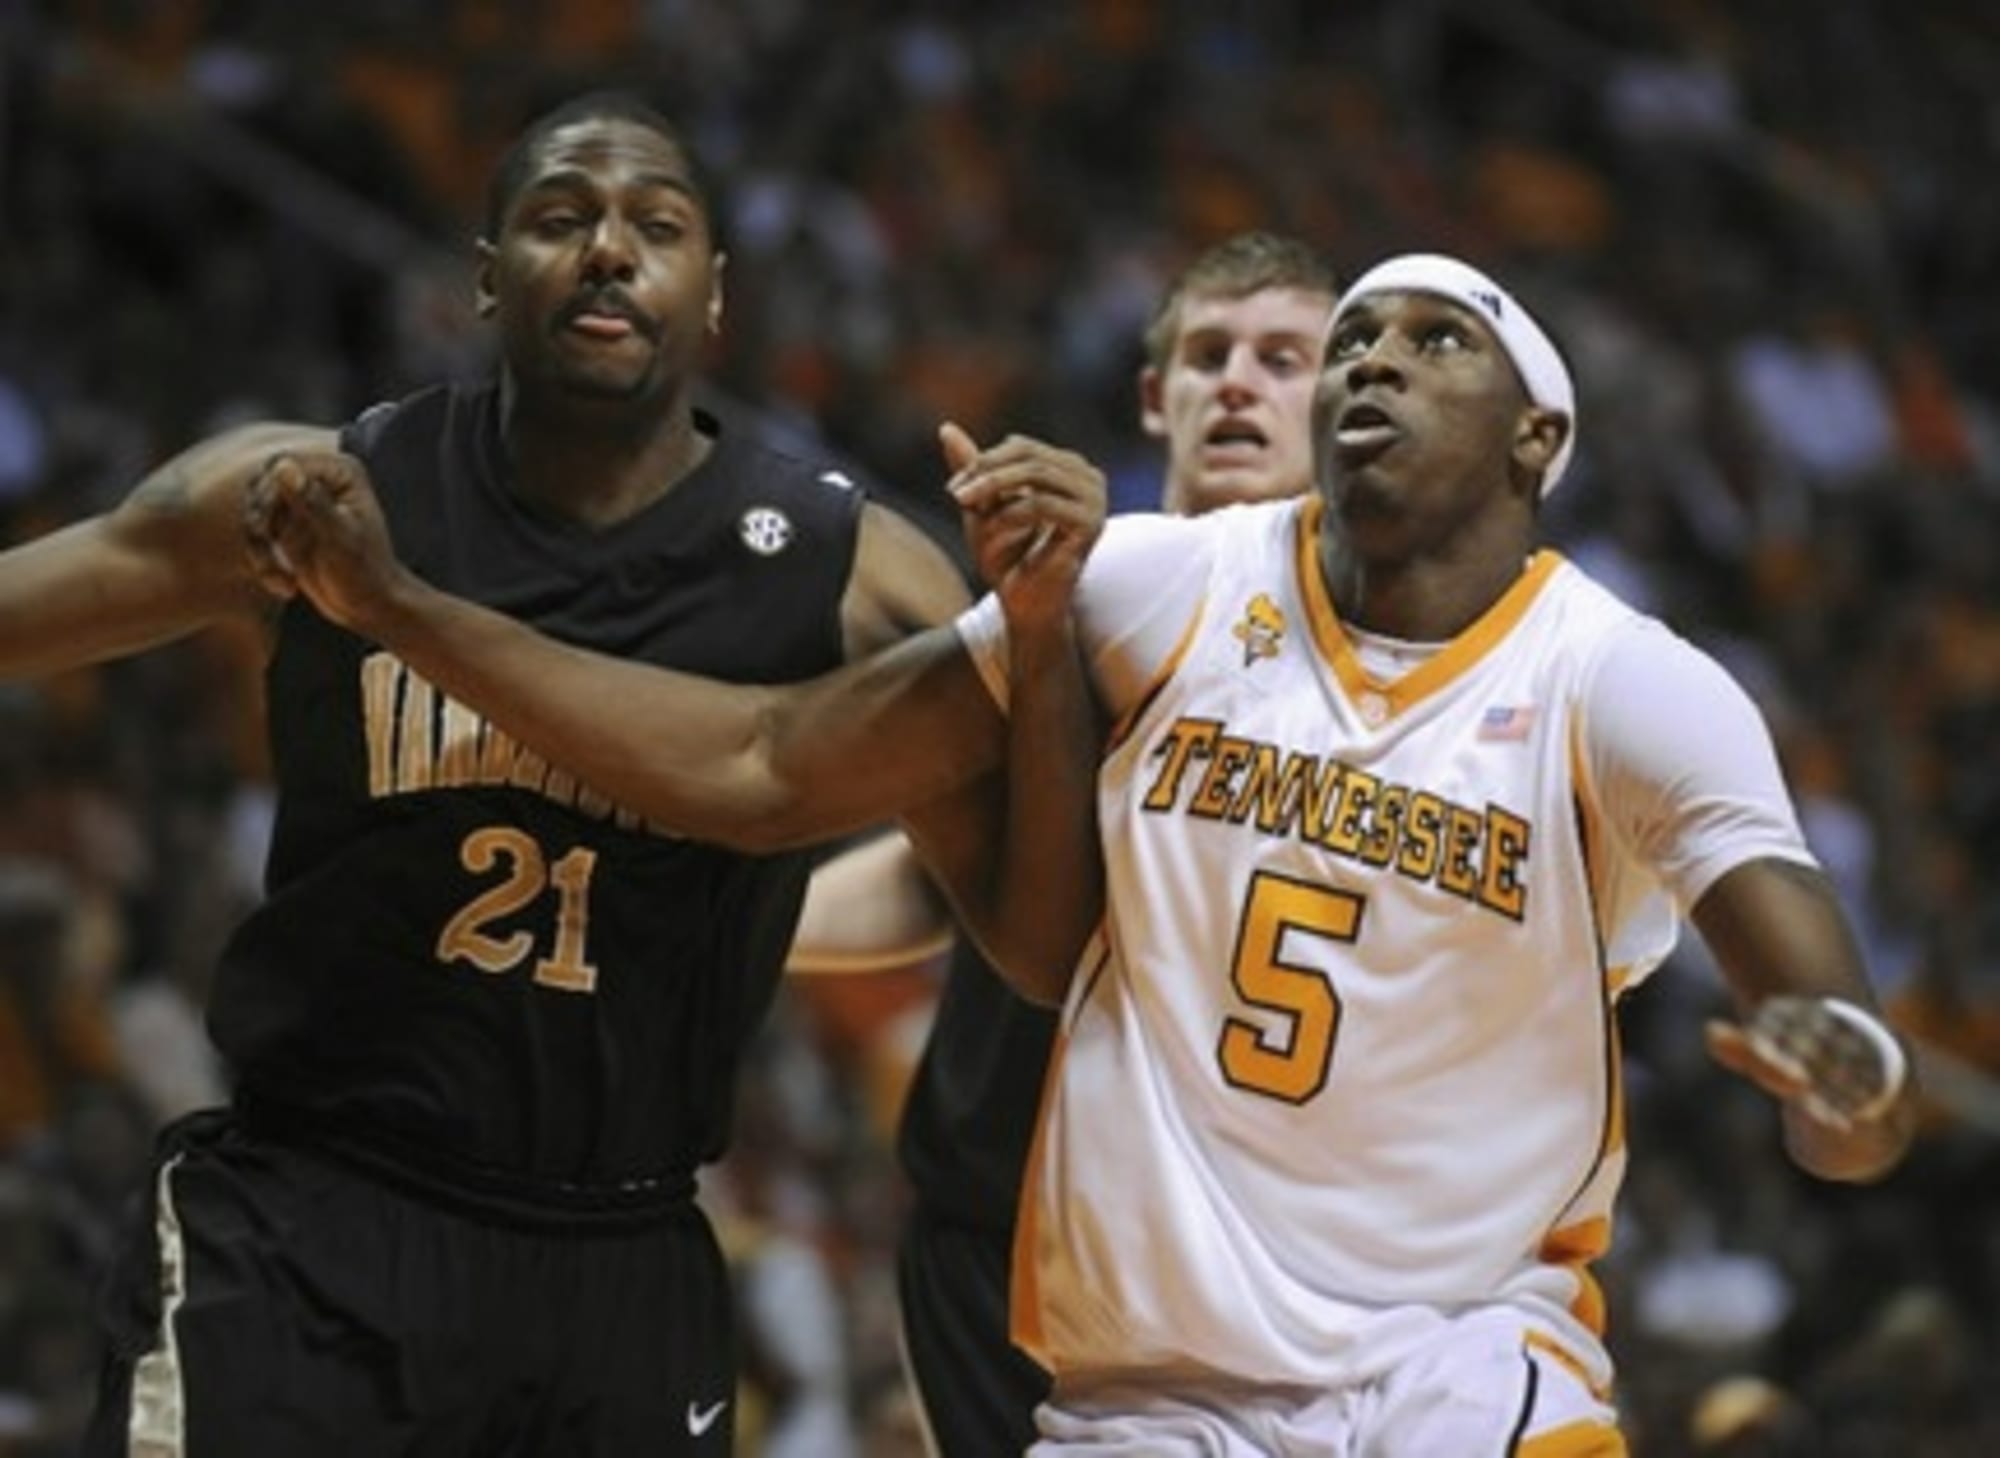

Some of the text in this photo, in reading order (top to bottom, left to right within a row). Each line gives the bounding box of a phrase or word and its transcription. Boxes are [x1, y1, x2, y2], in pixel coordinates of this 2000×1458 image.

[436, 826, 597, 992] 21
[1142, 717, 1531, 922] TENNESSEE
[1217, 869, 1366, 1105] 5
